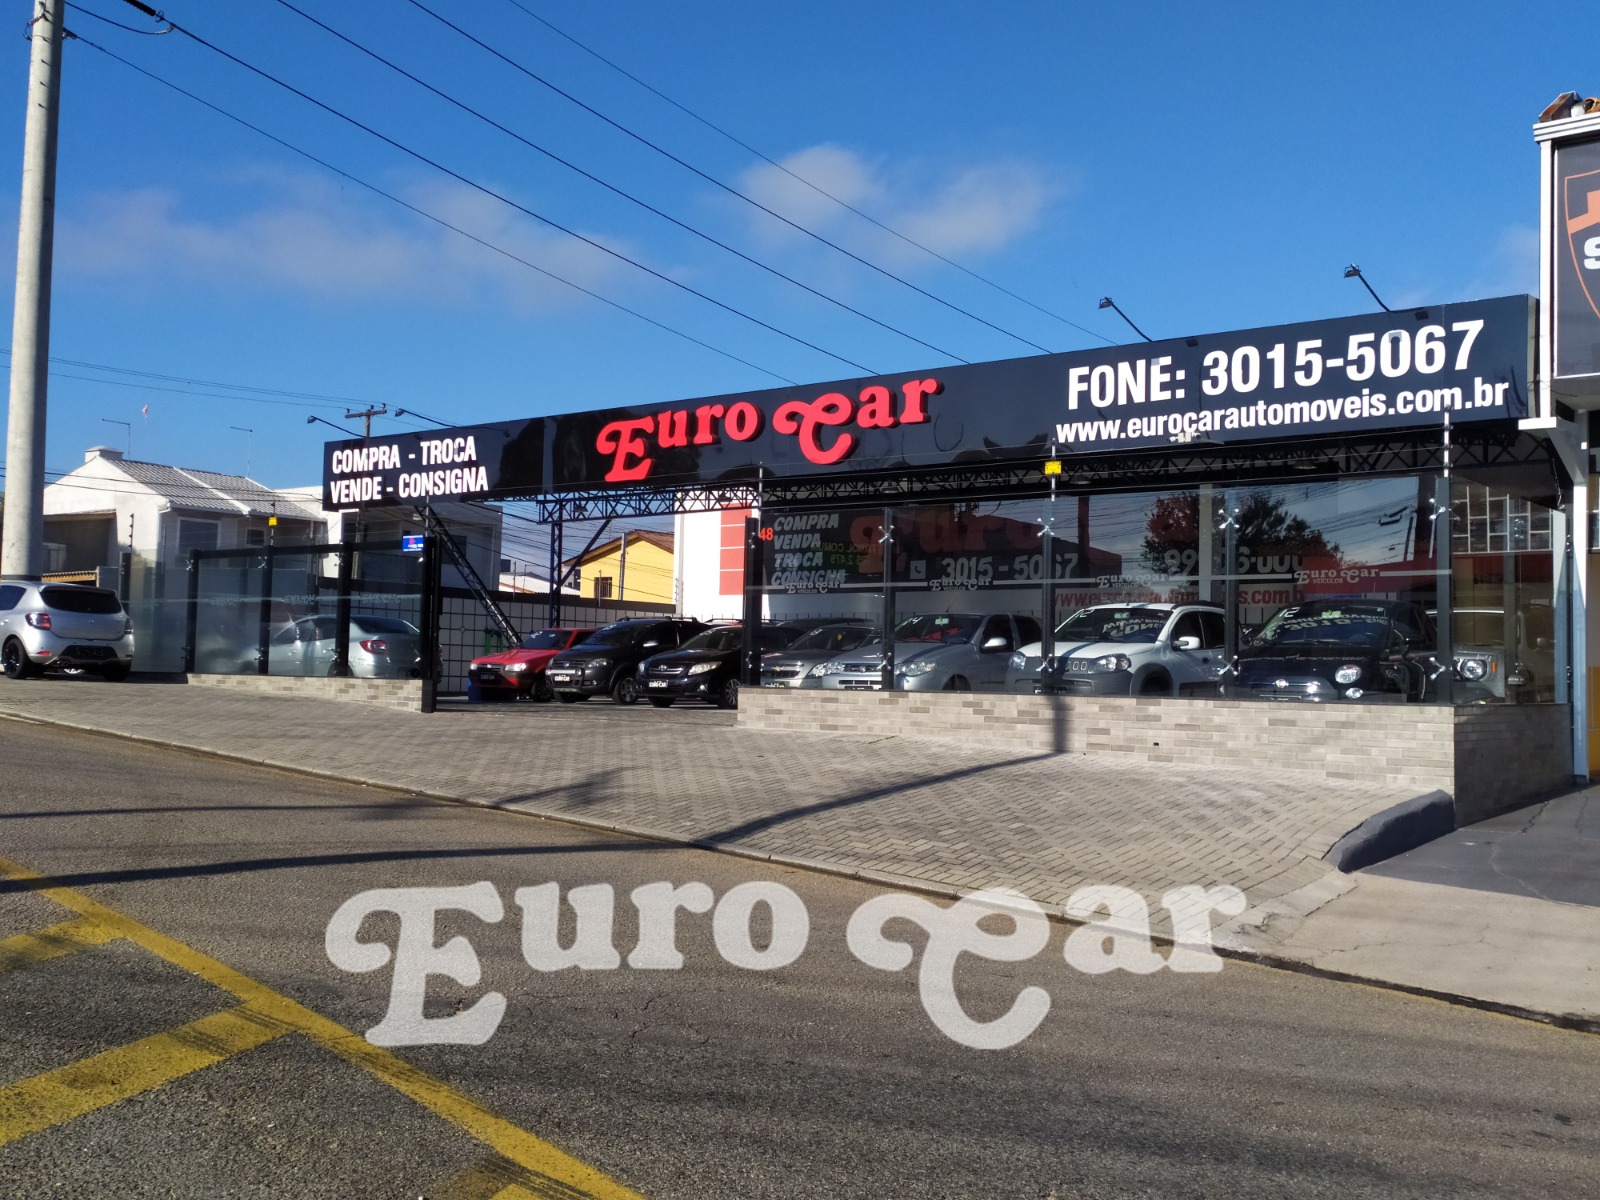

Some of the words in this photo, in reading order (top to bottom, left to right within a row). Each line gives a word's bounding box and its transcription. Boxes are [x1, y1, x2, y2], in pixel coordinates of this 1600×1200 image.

[1068, 356, 1186, 410] FONE:
[1202, 320, 1485, 396] 3015-5067
[1056, 377, 1509, 444] www.eurocarautomoveis.com.br
[596, 401, 762, 482] Euro
[772, 378, 944, 465] Car
[332, 445, 401, 474] COMPRA
[420, 436, 477, 465] TROCA
[330, 476, 382, 504] VENDE
[398, 466, 489, 498] CONSIGNA
[773, 513, 840, 532] COMPRA
[759, 527, 774, 541] 48
[774, 533, 822, 550] VENDA
[773, 551, 824, 568] TROCA
[770, 568, 847, 588] CONSIGNA
[1293, 569, 1338, 584] Euro
[1340, 568, 1379, 584] Car
